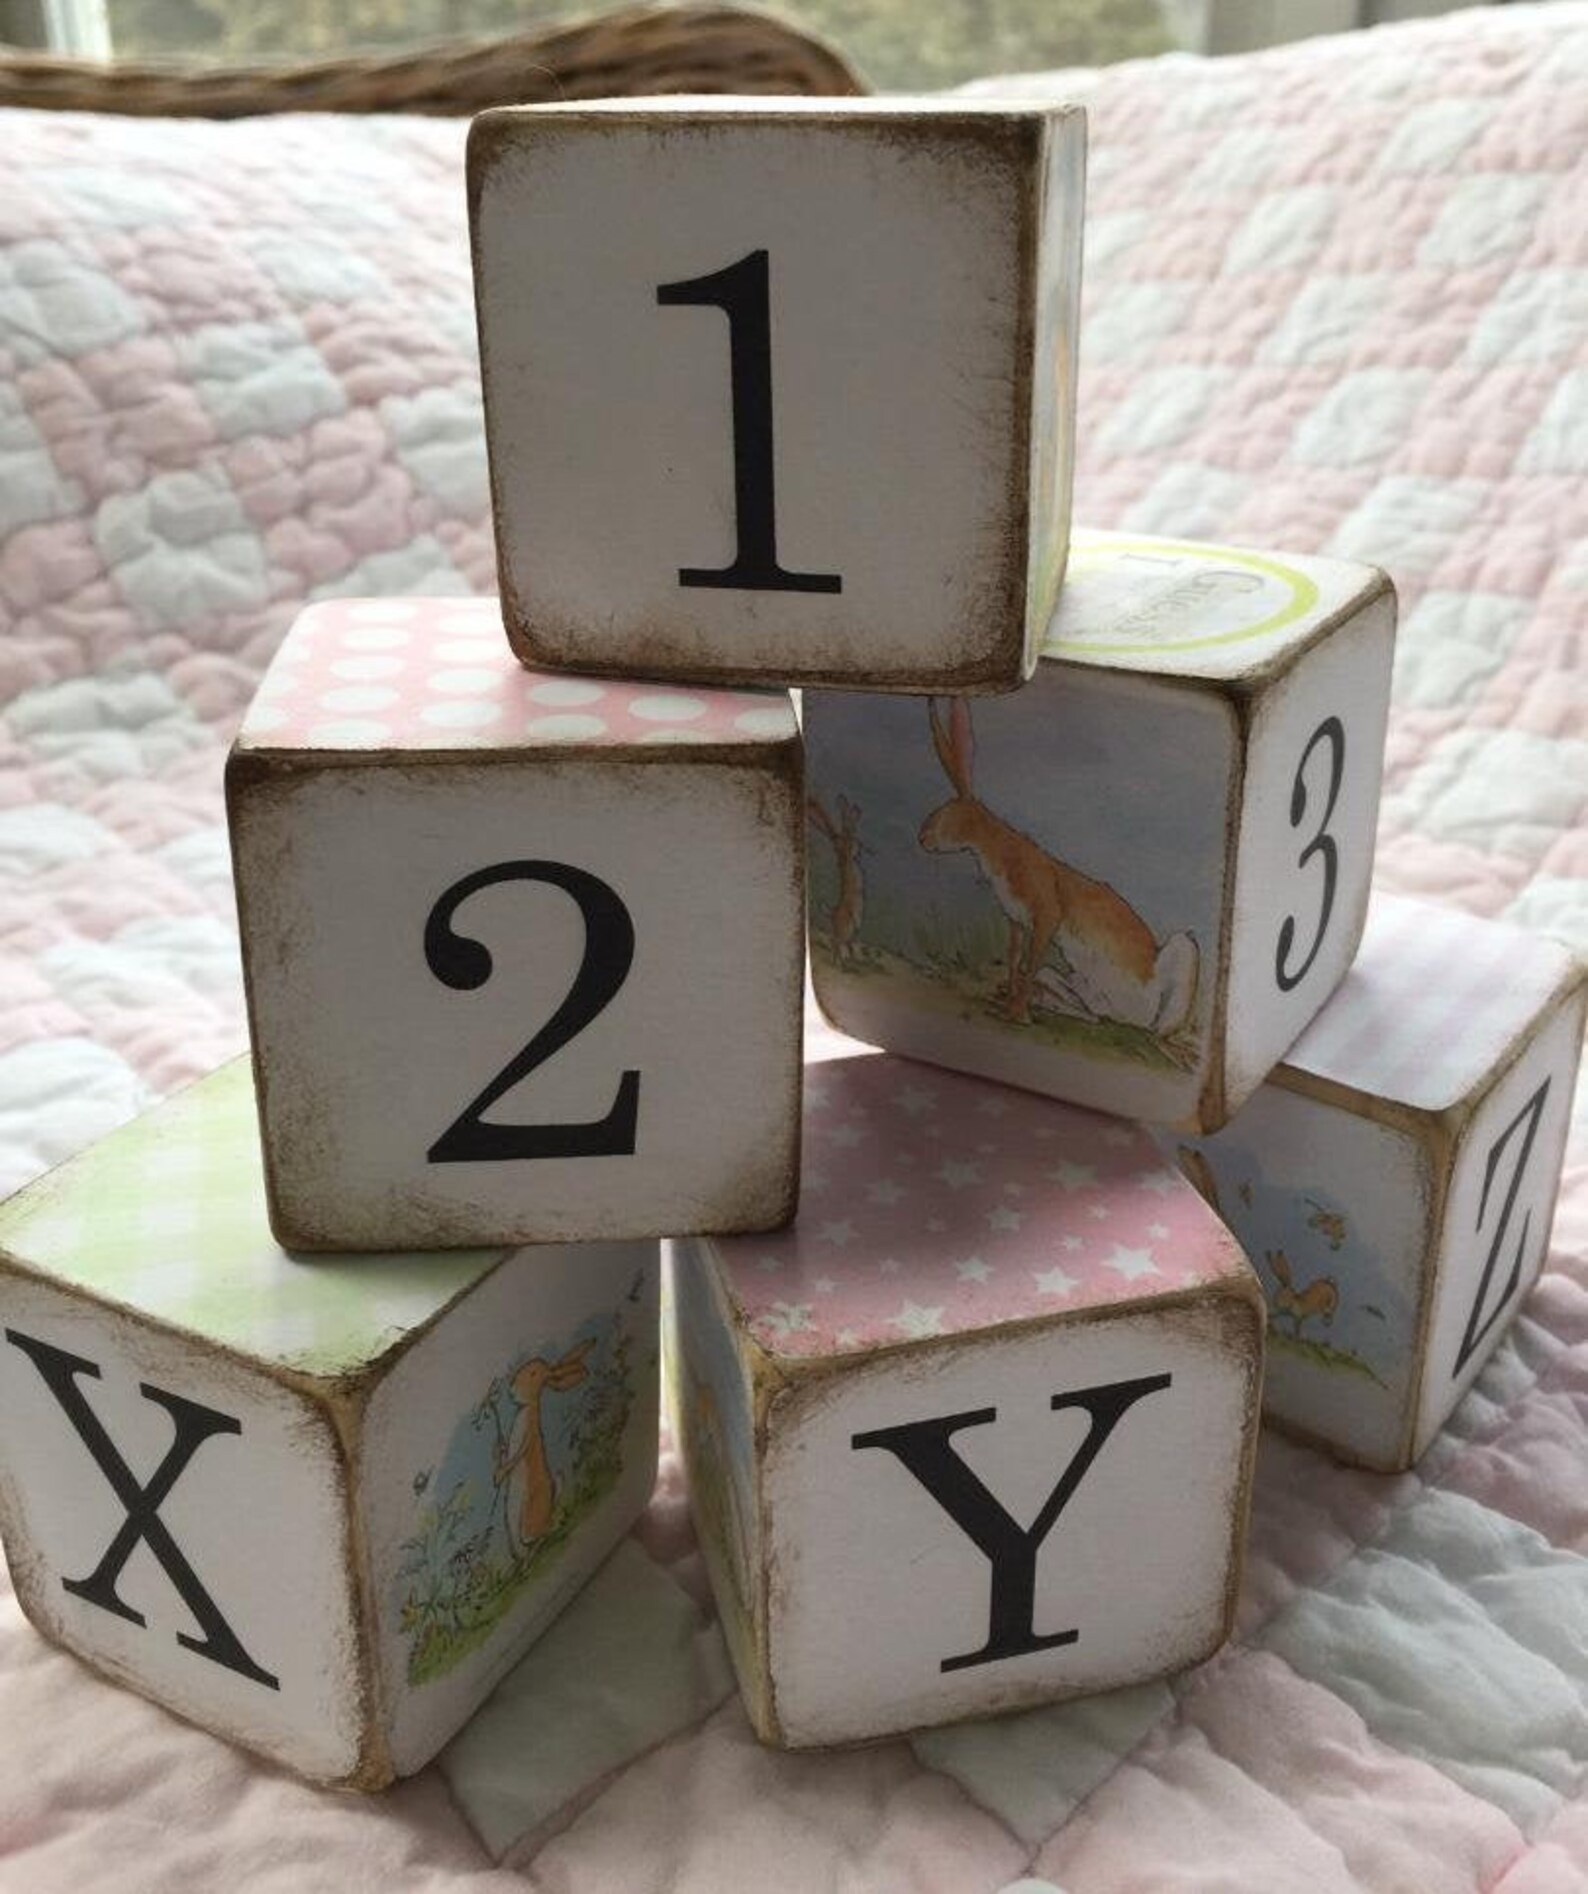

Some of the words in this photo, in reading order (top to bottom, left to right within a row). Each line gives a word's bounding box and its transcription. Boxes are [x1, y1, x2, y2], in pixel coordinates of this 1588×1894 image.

[656, 249, 842, 594] 1
[1276, 716, 1346, 992] 3
[423, 859, 642, 1165] 2
[1452, 1079, 1550, 1379] Z
[5, 1328, 281, 1691] X
[851, 1372, 1172, 1674] Y
